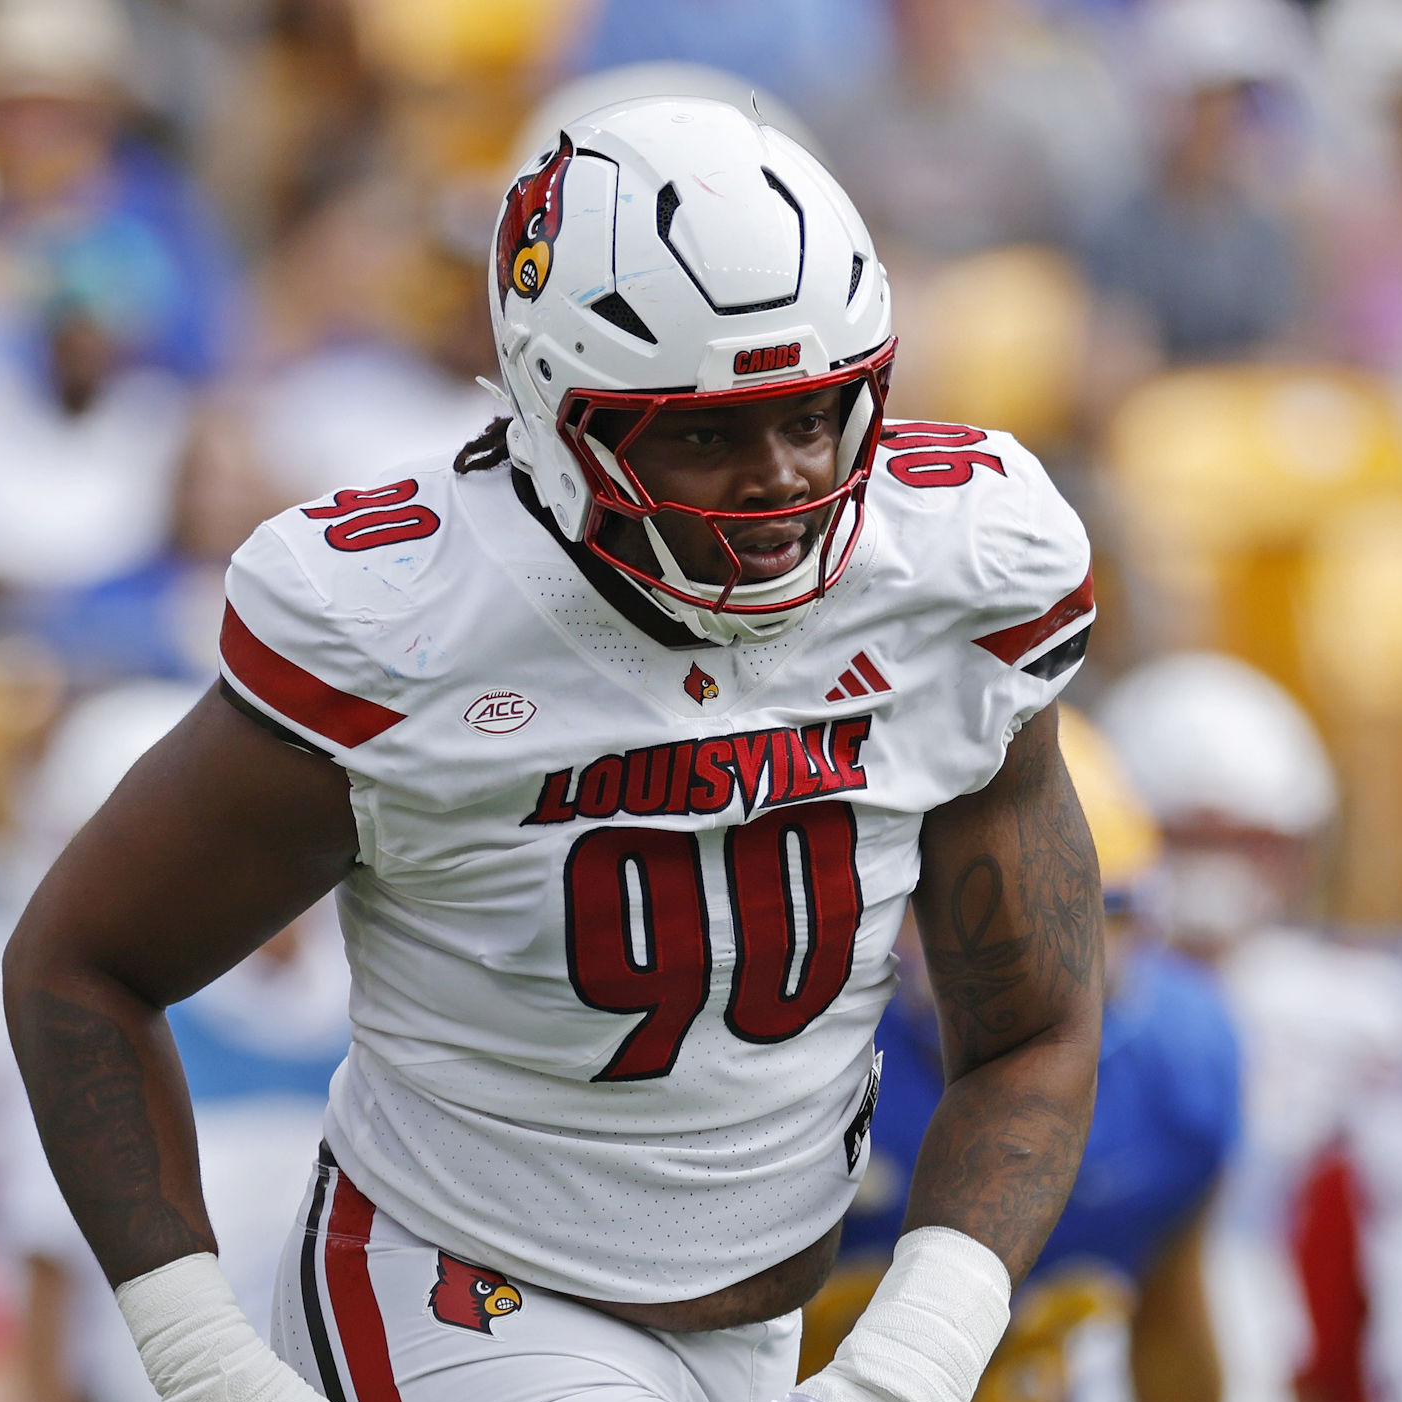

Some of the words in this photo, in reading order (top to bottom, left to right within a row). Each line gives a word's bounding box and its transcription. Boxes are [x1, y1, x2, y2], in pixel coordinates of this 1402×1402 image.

[733, 342, 801, 374] CARDS
[879, 422, 1009, 488] 90
[300, 478, 441, 552] 90
[476, 699, 525, 720] ACC
[519, 714, 873, 827] LOUISVILLE
[563, 800, 864, 1083] 90
